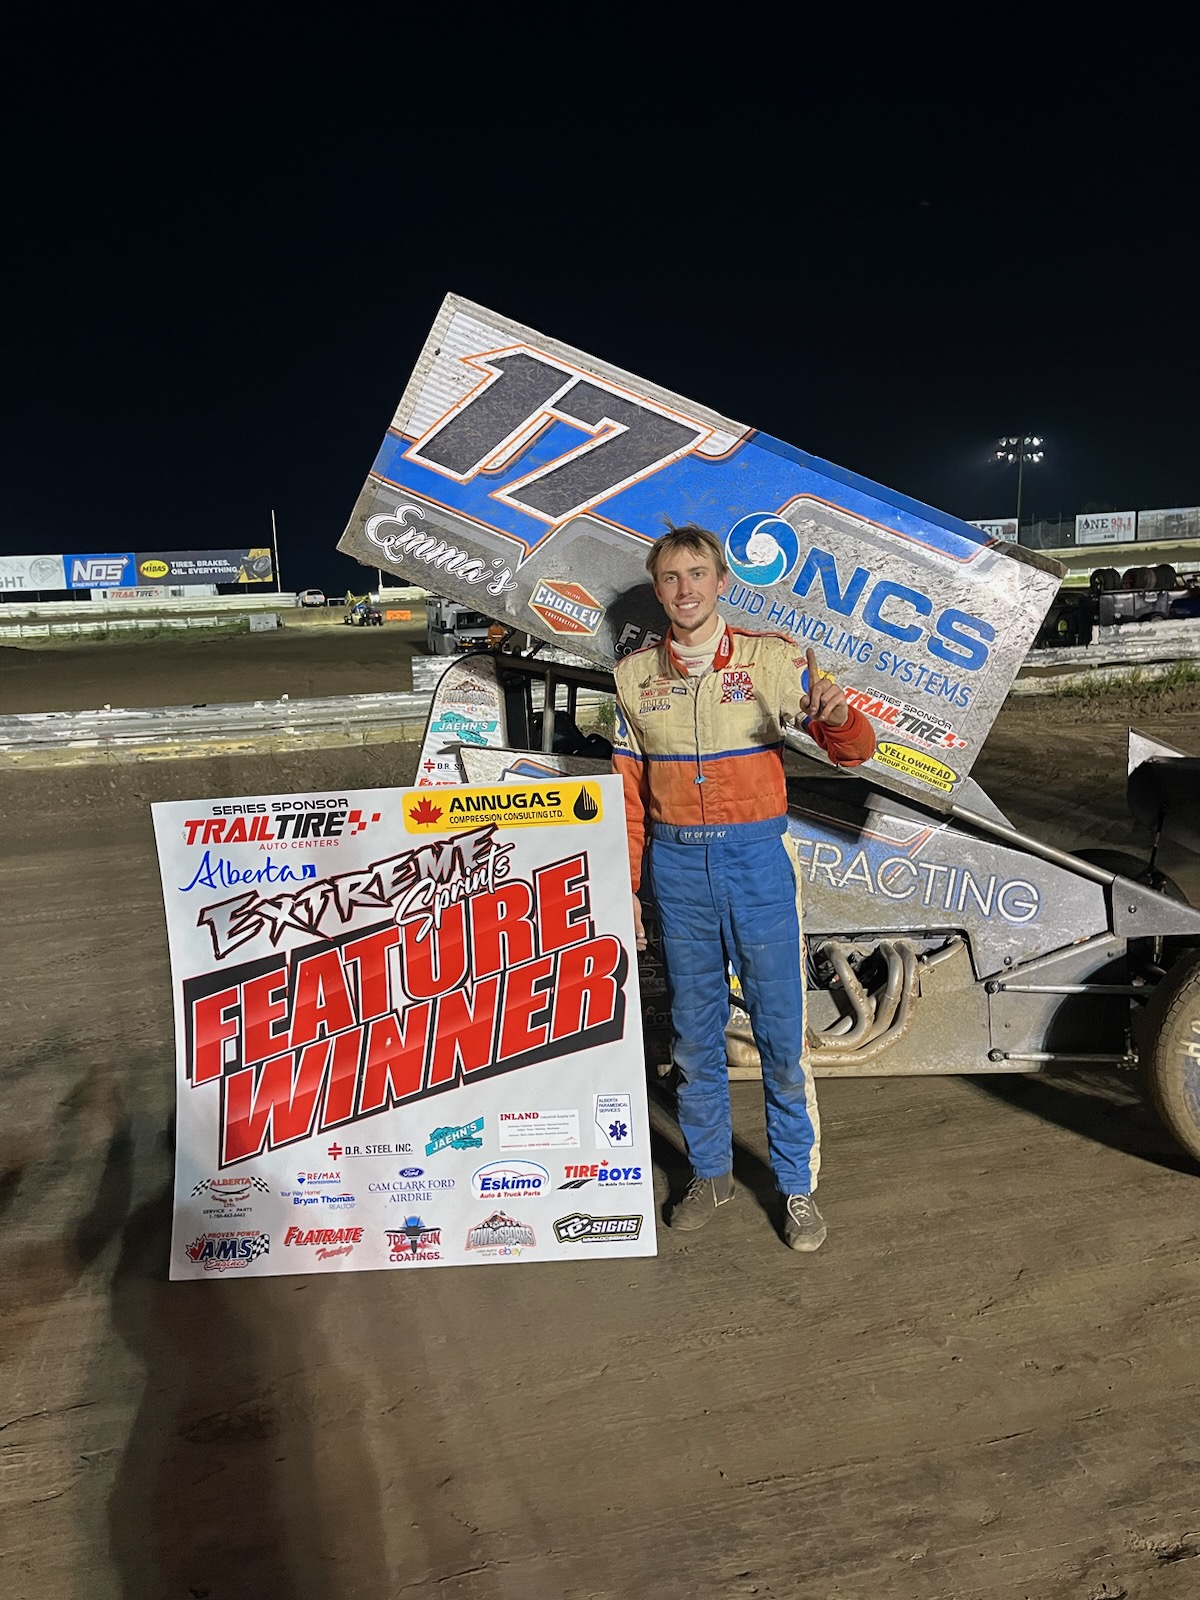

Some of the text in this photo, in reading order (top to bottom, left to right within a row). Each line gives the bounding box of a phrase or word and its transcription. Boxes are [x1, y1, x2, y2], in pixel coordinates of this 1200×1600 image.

[404, 345, 715, 526] 17
[366, 503, 518, 596] Emma's
[72, 557, 128, 582] NOS
[534, 585, 601, 627] CHURLEY
[792, 546, 996, 672] NCS
[766, 601, 874, 665] HANDLING
[874, 650, 973, 708] SYSTEMS
[866, 687, 952, 730] SERIES SPONSOR
[438, 722, 489, 731] JAEHN'S
[877, 755, 948, 789] GROUP OF COMPANIES
[884, 744, 952, 780] YELLOWHEAD
[212, 798, 349, 816] SERIES SPONSOR
[449, 791, 562, 813] ANNUGAS
[449, 809, 564, 824] COMPRESSION CONSULTING LTD.
[258, 839, 339, 851] AUTO CENTERS
[178, 850, 303, 892] Alberta
[197, 823, 501, 961] EXTREME
[396, 842, 516, 943] Sprints
[186, 853, 595, 1087] FEATURE
[219, 935, 627, 1169] WINNER
[500, 1112, 539, 1121] INLAND
[432, 1122, 477, 1151] JAEHN'S
[345, 1143, 414, 1155] D.R. STEEL INC.
[210, 1178, 252, 1187] ALBERTA
[307, 1172, 341, 1180] RE/MAX
[368, 1179, 455, 1192] CAM CLARK FORD
[480, 1176, 542, 1191] Eskimo
[293, 1195, 355, 1206] Bryan Thomas
[389, 1192, 433, 1203] AIRDRIE
[284, 1226, 364, 1247] FLATRATE
[590, 1220, 638, 1234] SIGNS
[420, 1231, 441, 1245] GUN
[200, 1238, 254, 1260] AMS
[389, 1251, 441, 1262] COATINGS
[498, 1246, 522, 1257] ebay
